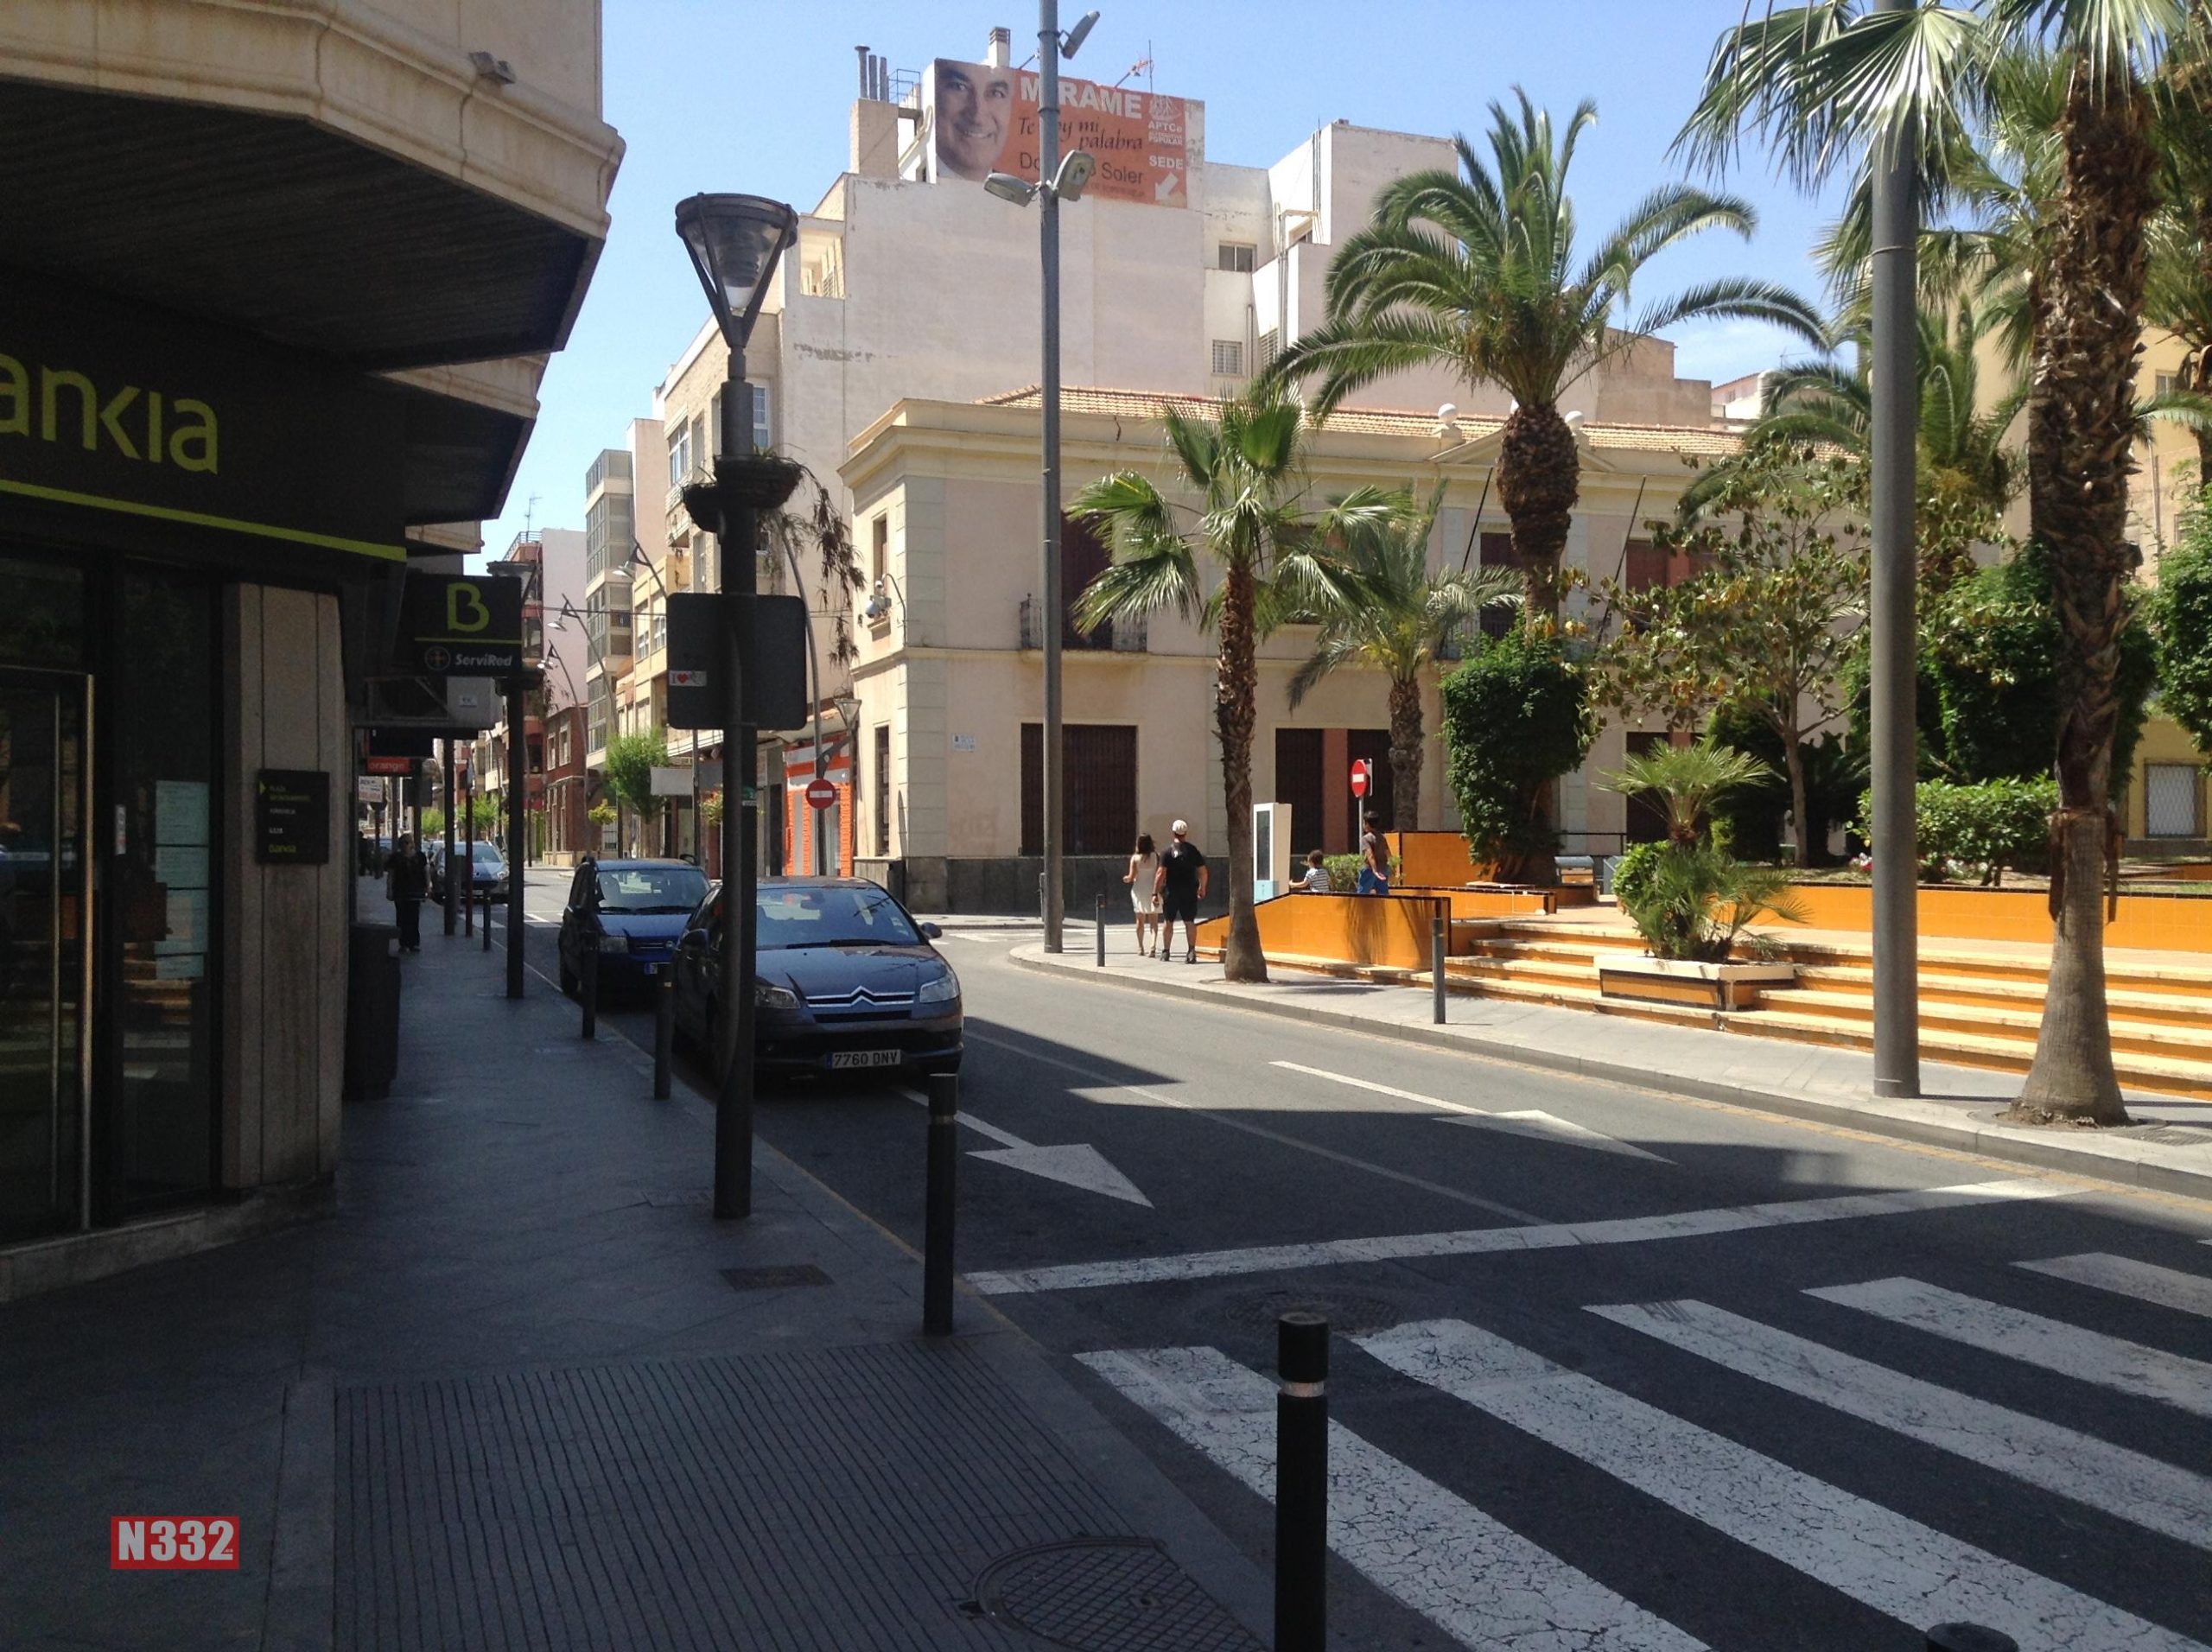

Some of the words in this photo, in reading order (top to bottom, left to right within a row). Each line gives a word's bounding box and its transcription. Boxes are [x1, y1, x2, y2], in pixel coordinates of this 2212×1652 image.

[1020, 76, 1142, 119] MRAME
[1078, 116, 1100, 132] mi
[1078, 126, 1142, 151] palabra
[1148, 156, 1184, 170] SEDE
[1101, 162, 1143, 184] Soler
[447, 581, 490, 632] B
[454, 653, 512, 667] ServiRed
[369, 762, 406, 772] orange
[834, 1053, 868, 1067] 7760
[872, 1051, 897, 1065] DNV
